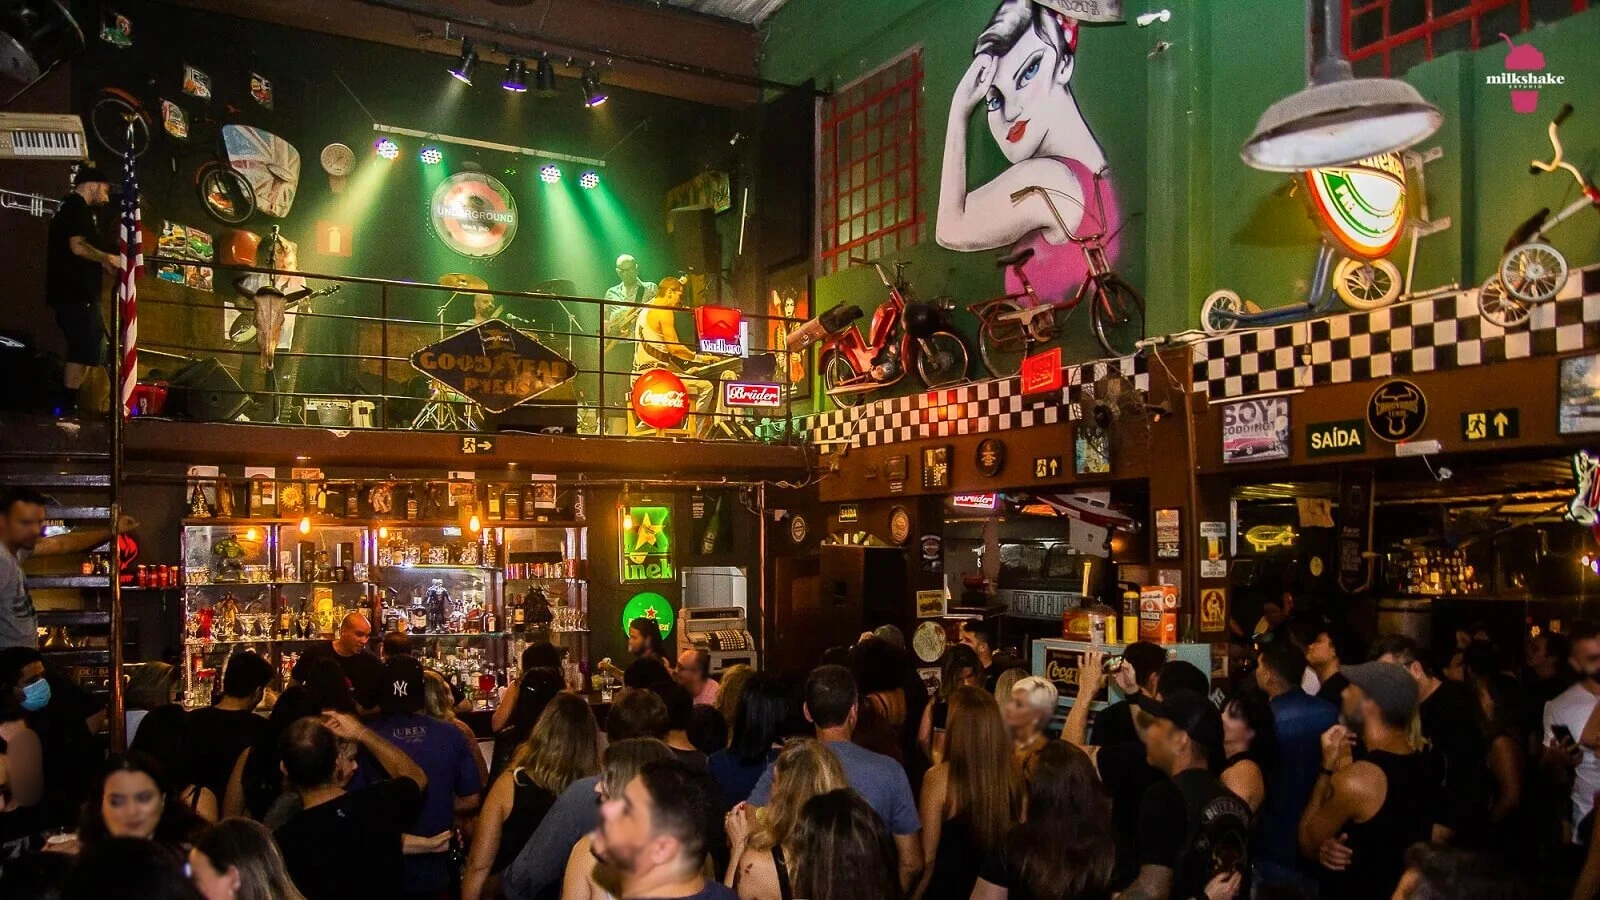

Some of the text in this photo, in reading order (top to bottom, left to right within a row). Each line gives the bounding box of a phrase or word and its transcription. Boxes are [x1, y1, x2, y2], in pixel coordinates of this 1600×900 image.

[702, 339, 742, 355] Marlboro
[729, 385, 778, 403] Brüder
[1311, 427, 1361, 449] SAÍDA
